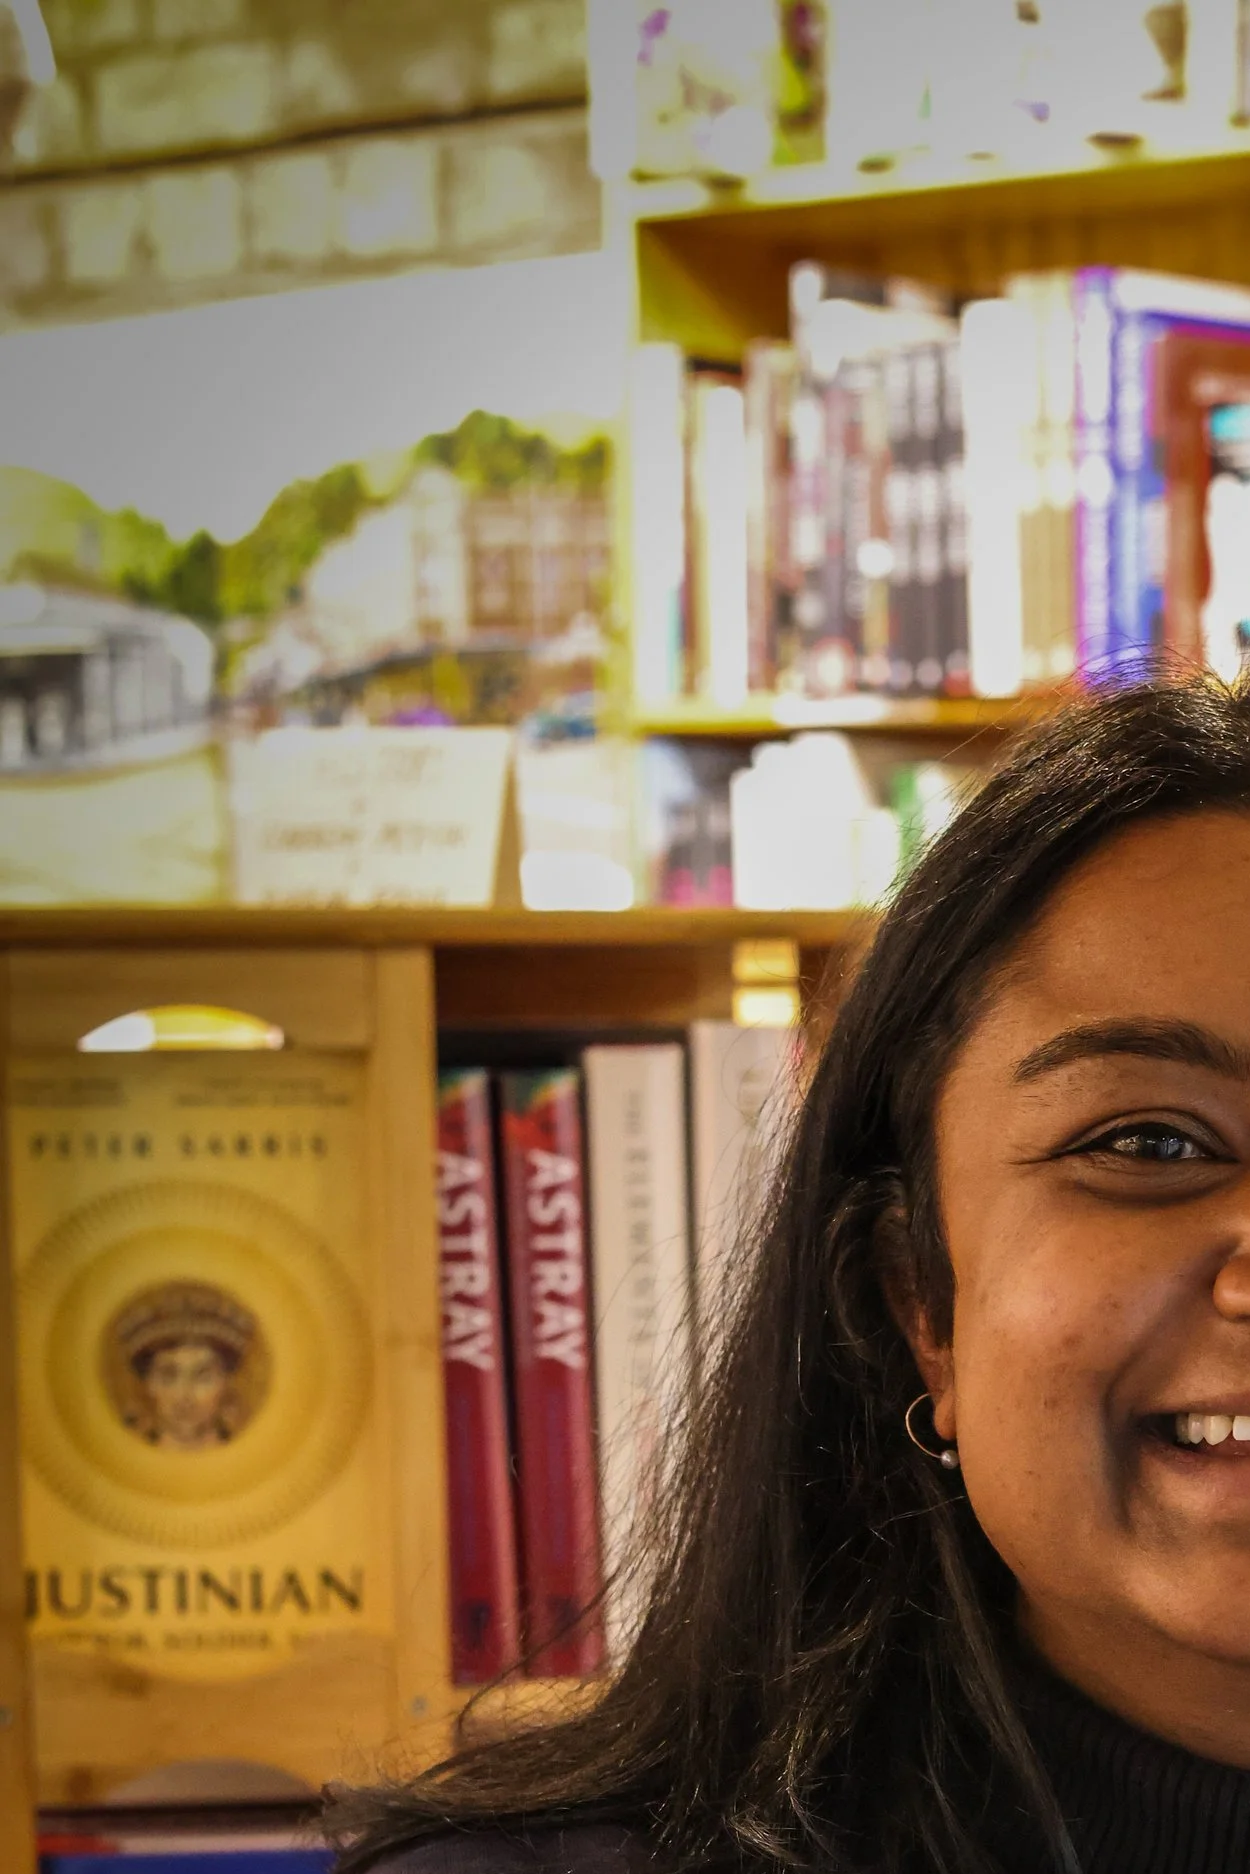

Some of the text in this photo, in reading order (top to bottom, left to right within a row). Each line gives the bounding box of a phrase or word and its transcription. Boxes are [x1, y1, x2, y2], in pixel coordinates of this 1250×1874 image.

[437, 1149, 495, 1372] ASTRAY
[527, 1148, 584, 1370] ASTRAY
[21, 1562, 366, 1622] JUSTINIAN
